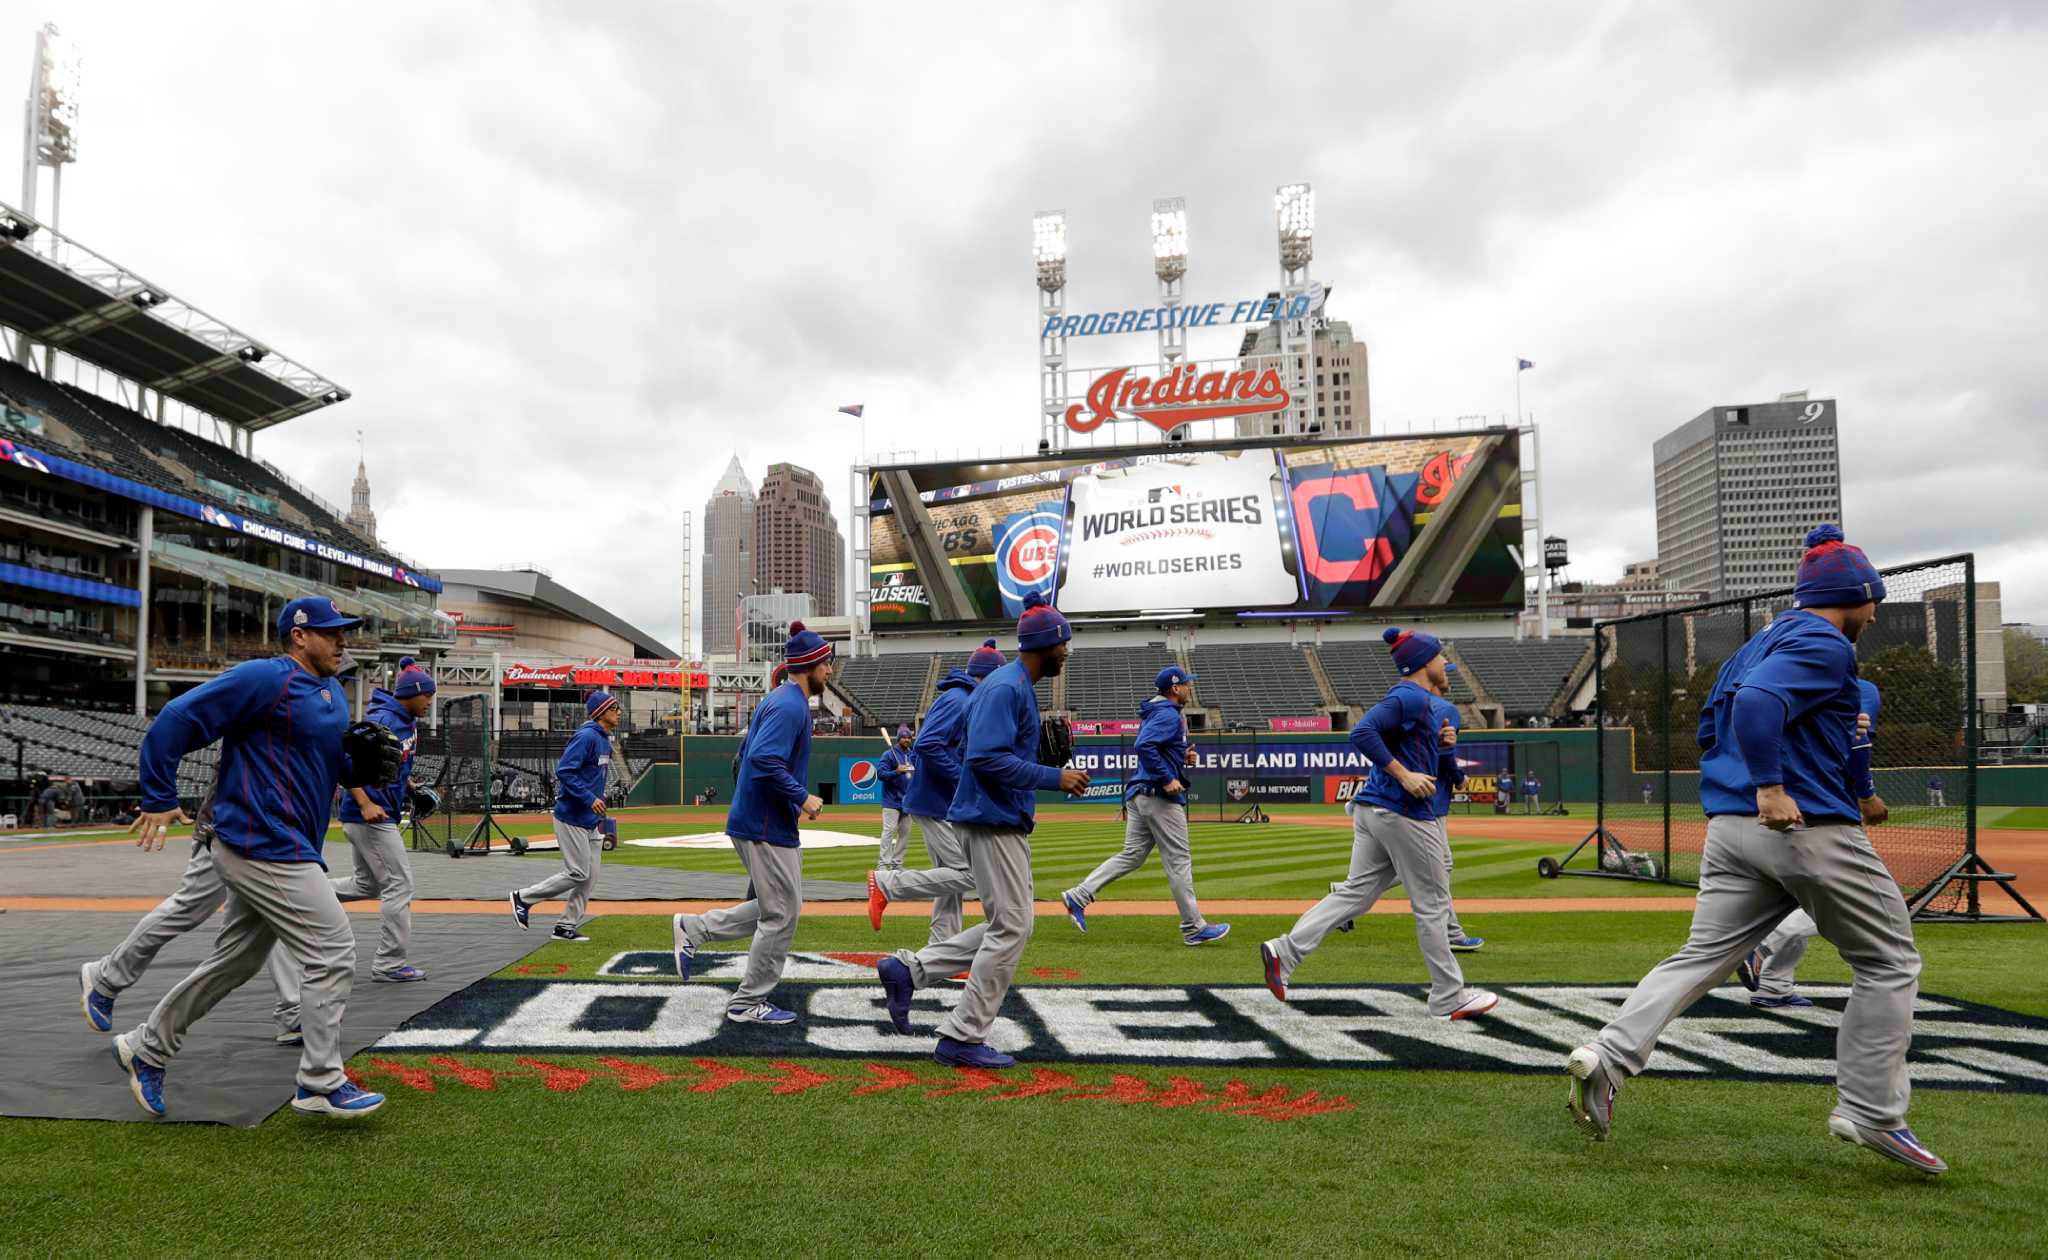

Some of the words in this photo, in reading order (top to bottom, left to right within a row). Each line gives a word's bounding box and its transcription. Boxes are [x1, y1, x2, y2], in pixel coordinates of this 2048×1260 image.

[1041, 302, 1224, 337] PROGRESSIVE
[1230, 294, 1313, 323] FIELD
[1064, 363, 1290, 434] Indians
[1083, 505, 1165, 541] WORLD
[1170, 494, 1261, 525] SERIES
[242, 520, 282, 543] CHICAGO
[283, 534, 306, 550] CUBS
[317, 545, 363, 567] CLEVELAND
[1092, 553, 1242, 578] #WORLDSERIES
[509, 667, 568, 682] Budweiser
[1104, 754, 1138, 769] CUB
[1303, 752, 1374, 767] INDIAN
[852, 791, 875, 800] pepsi
[1268, 785, 1309, 794] NETWORK
